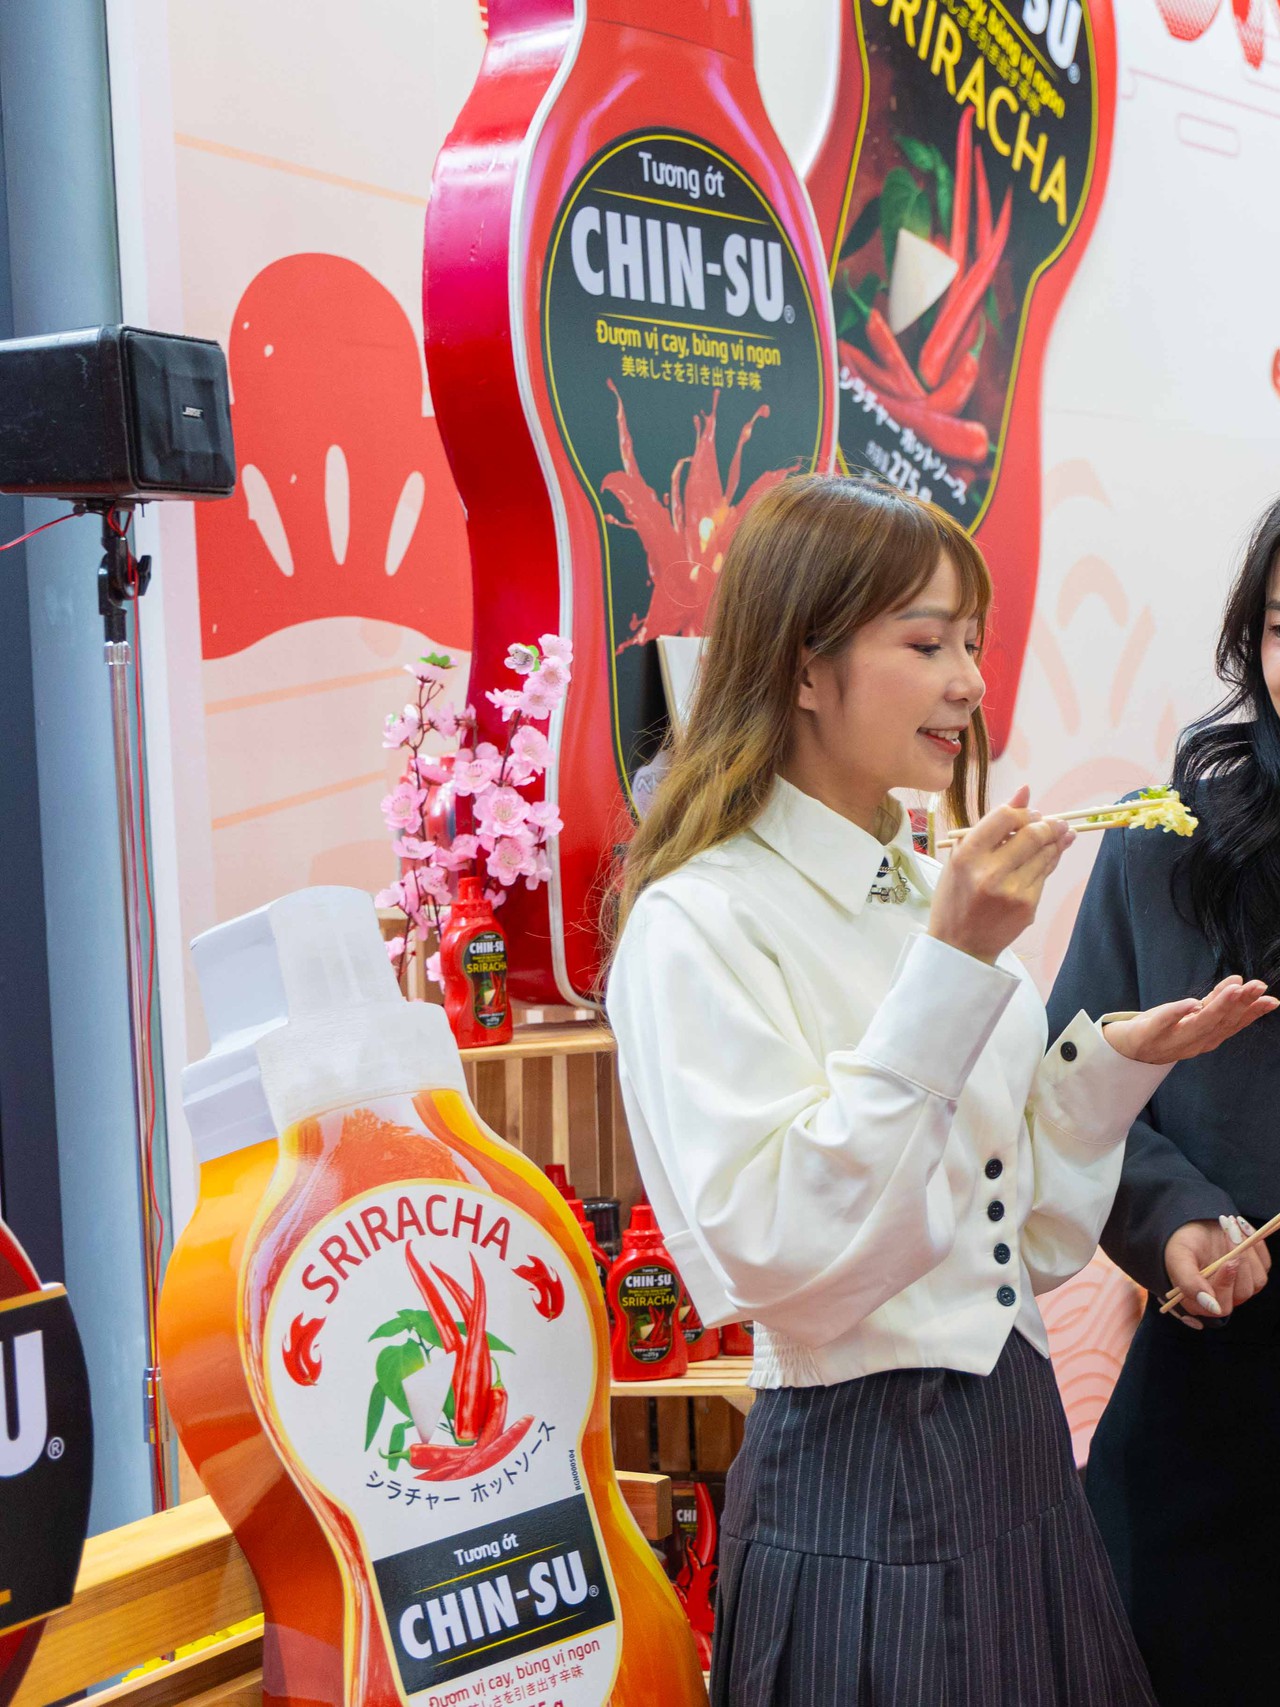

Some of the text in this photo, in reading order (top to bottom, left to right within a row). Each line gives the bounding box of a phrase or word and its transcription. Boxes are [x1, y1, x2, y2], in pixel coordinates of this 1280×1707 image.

[868, 0, 1067, 226] RIRACHA
[704, 165, 726, 198] ớt
[571, 205, 785, 322] CHIN-SU
[644, 327, 659, 356] vị
[661, 333, 690, 359] cay,
[692, 332, 728, 365] bùng
[731, 338, 745, 367] vị
[746, 344, 782, 369] ngon
[621, 355, 763, 392] 美味しさを引き出す辛味
[301, 1194, 511, 1305] SRIRACHA
[622, 1295, 677, 1307] SRIRACHA
[625, 1273, 672, 1288] CHIN-SU
[366, 1421, 556, 1510] シラチャー ホットソース
[568, 1449, 581, 1491] BGN000504
[502, 1533, 519, 1550] ớt
[398, 1550, 588, 1660] CHIN-SU
[472, 1679, 487, 1697] vị
[488, 1672, 515, 1689] cay,
[516, 1657, 550, 1680] bùng
[552, 1649, 566, 1667] vị
[568, 1640, 600, 1661] ngon
